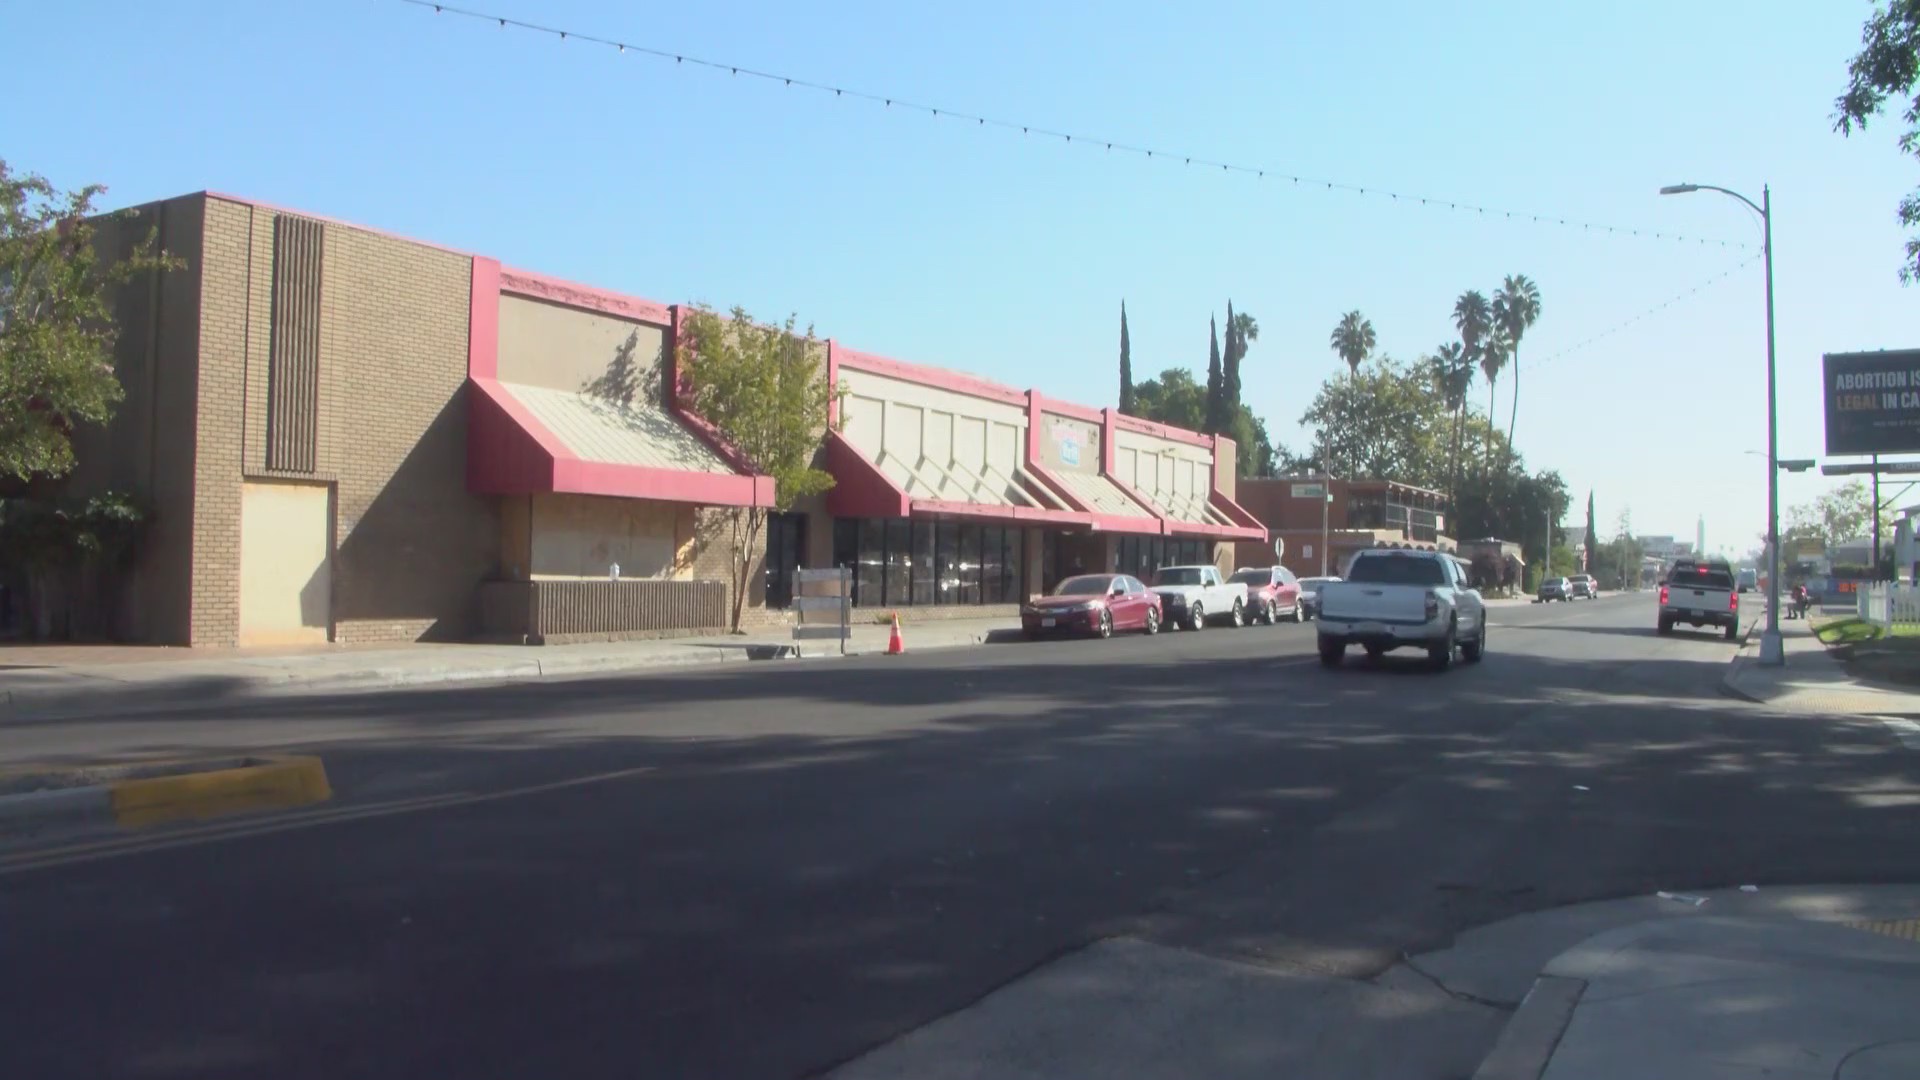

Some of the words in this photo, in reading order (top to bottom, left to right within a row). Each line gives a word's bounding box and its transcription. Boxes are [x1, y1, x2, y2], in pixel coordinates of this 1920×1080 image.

[1836, 371, 1907, 390] ABORTION
[1910, 370, 1920, 387] IS
[1836, 393, 1878, 410] LEGAL
[1882, 393, 1897, 409] IN
